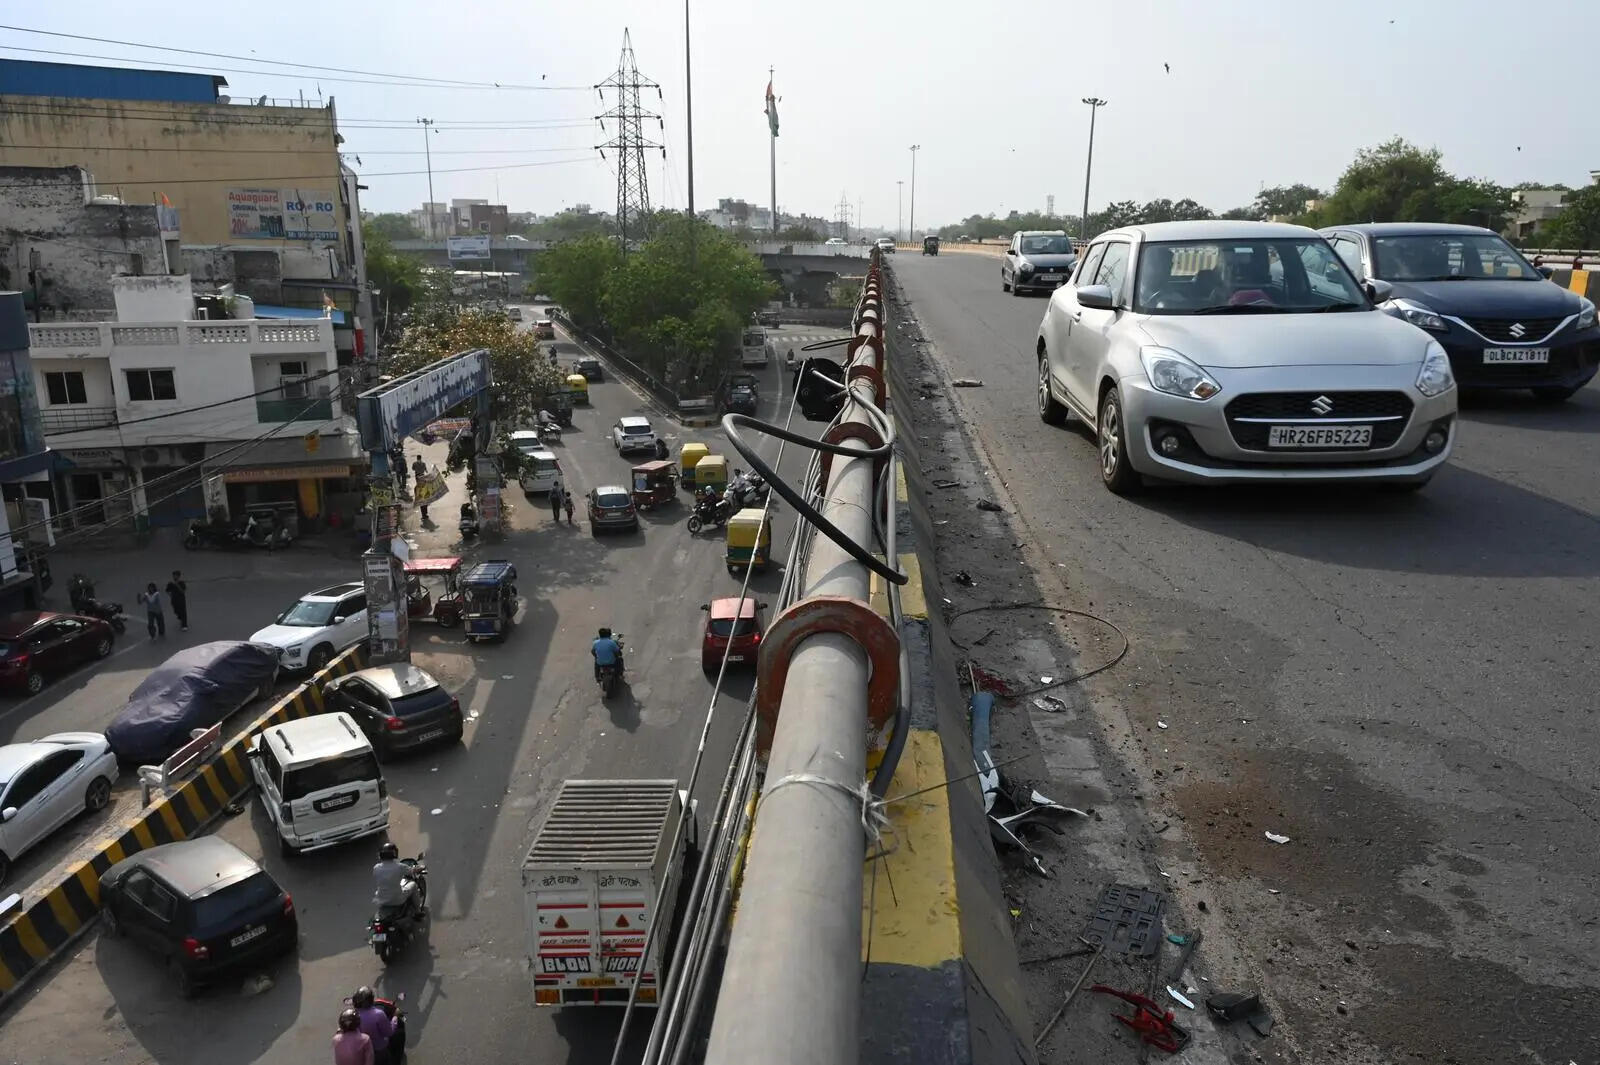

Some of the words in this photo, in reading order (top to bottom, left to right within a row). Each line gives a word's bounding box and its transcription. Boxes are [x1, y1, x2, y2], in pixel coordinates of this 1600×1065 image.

[229, 191, 279, 203] Aquaguard
[315, 202, 333, 212] RO
[1278, 429, 1371, 445] HR26FB5223
[543, 957, 589, 972] BLOW
